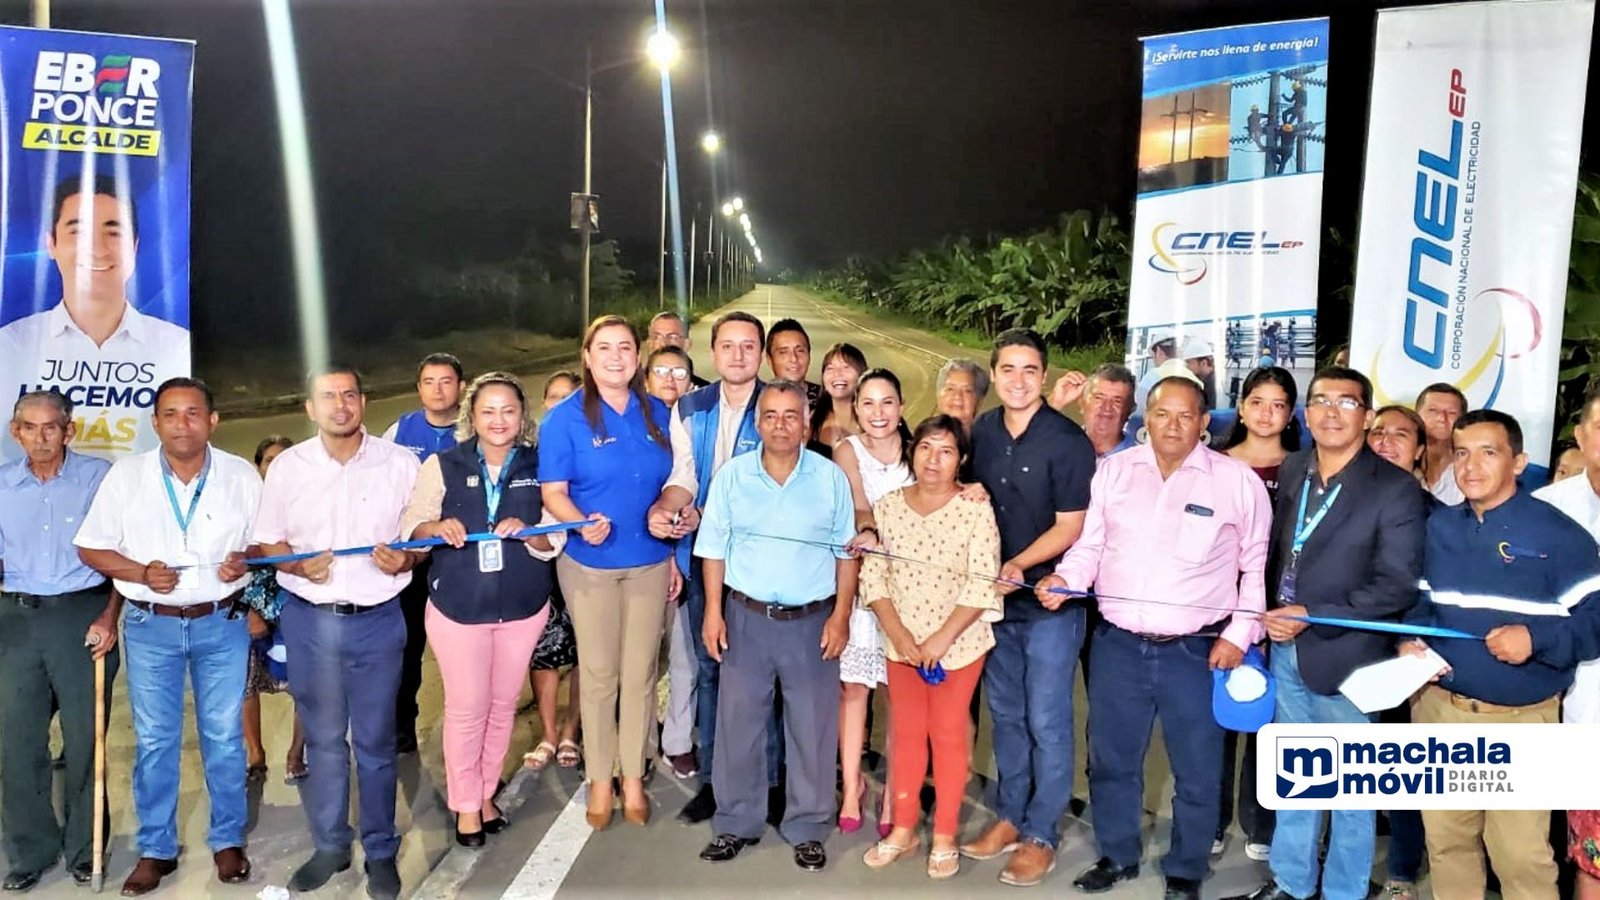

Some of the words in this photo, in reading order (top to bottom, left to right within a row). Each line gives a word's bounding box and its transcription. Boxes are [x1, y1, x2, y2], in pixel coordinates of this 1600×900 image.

[1200, 49, 1220, 58] nos
[1222, 44, 1250, 55] llena
[1252, 42, 1266, 52] de
[1269, 36, 1319, 52] energía!
[34, 51, 161, 98] EBER
[31, 92, 157, 126] PONCE
[34, 128, 151, 150] ALCALDE
[1465, 121, 1481, 204] ELECTRICIDAD
[1403, 119, 1463, 369] CNEL
[1449, 68, 1467, 118] EP
[1464, 207, 1474, 223] DE
[1281, 241, 1303, 249] EP
[1458, 226, 1472, 284] NACIONAL
[1451, 285, 1467, 369] CORPORACIÓN
[42, 359, 155, 383] JUNTOS
[18, 384, 157, 408] CEMO
